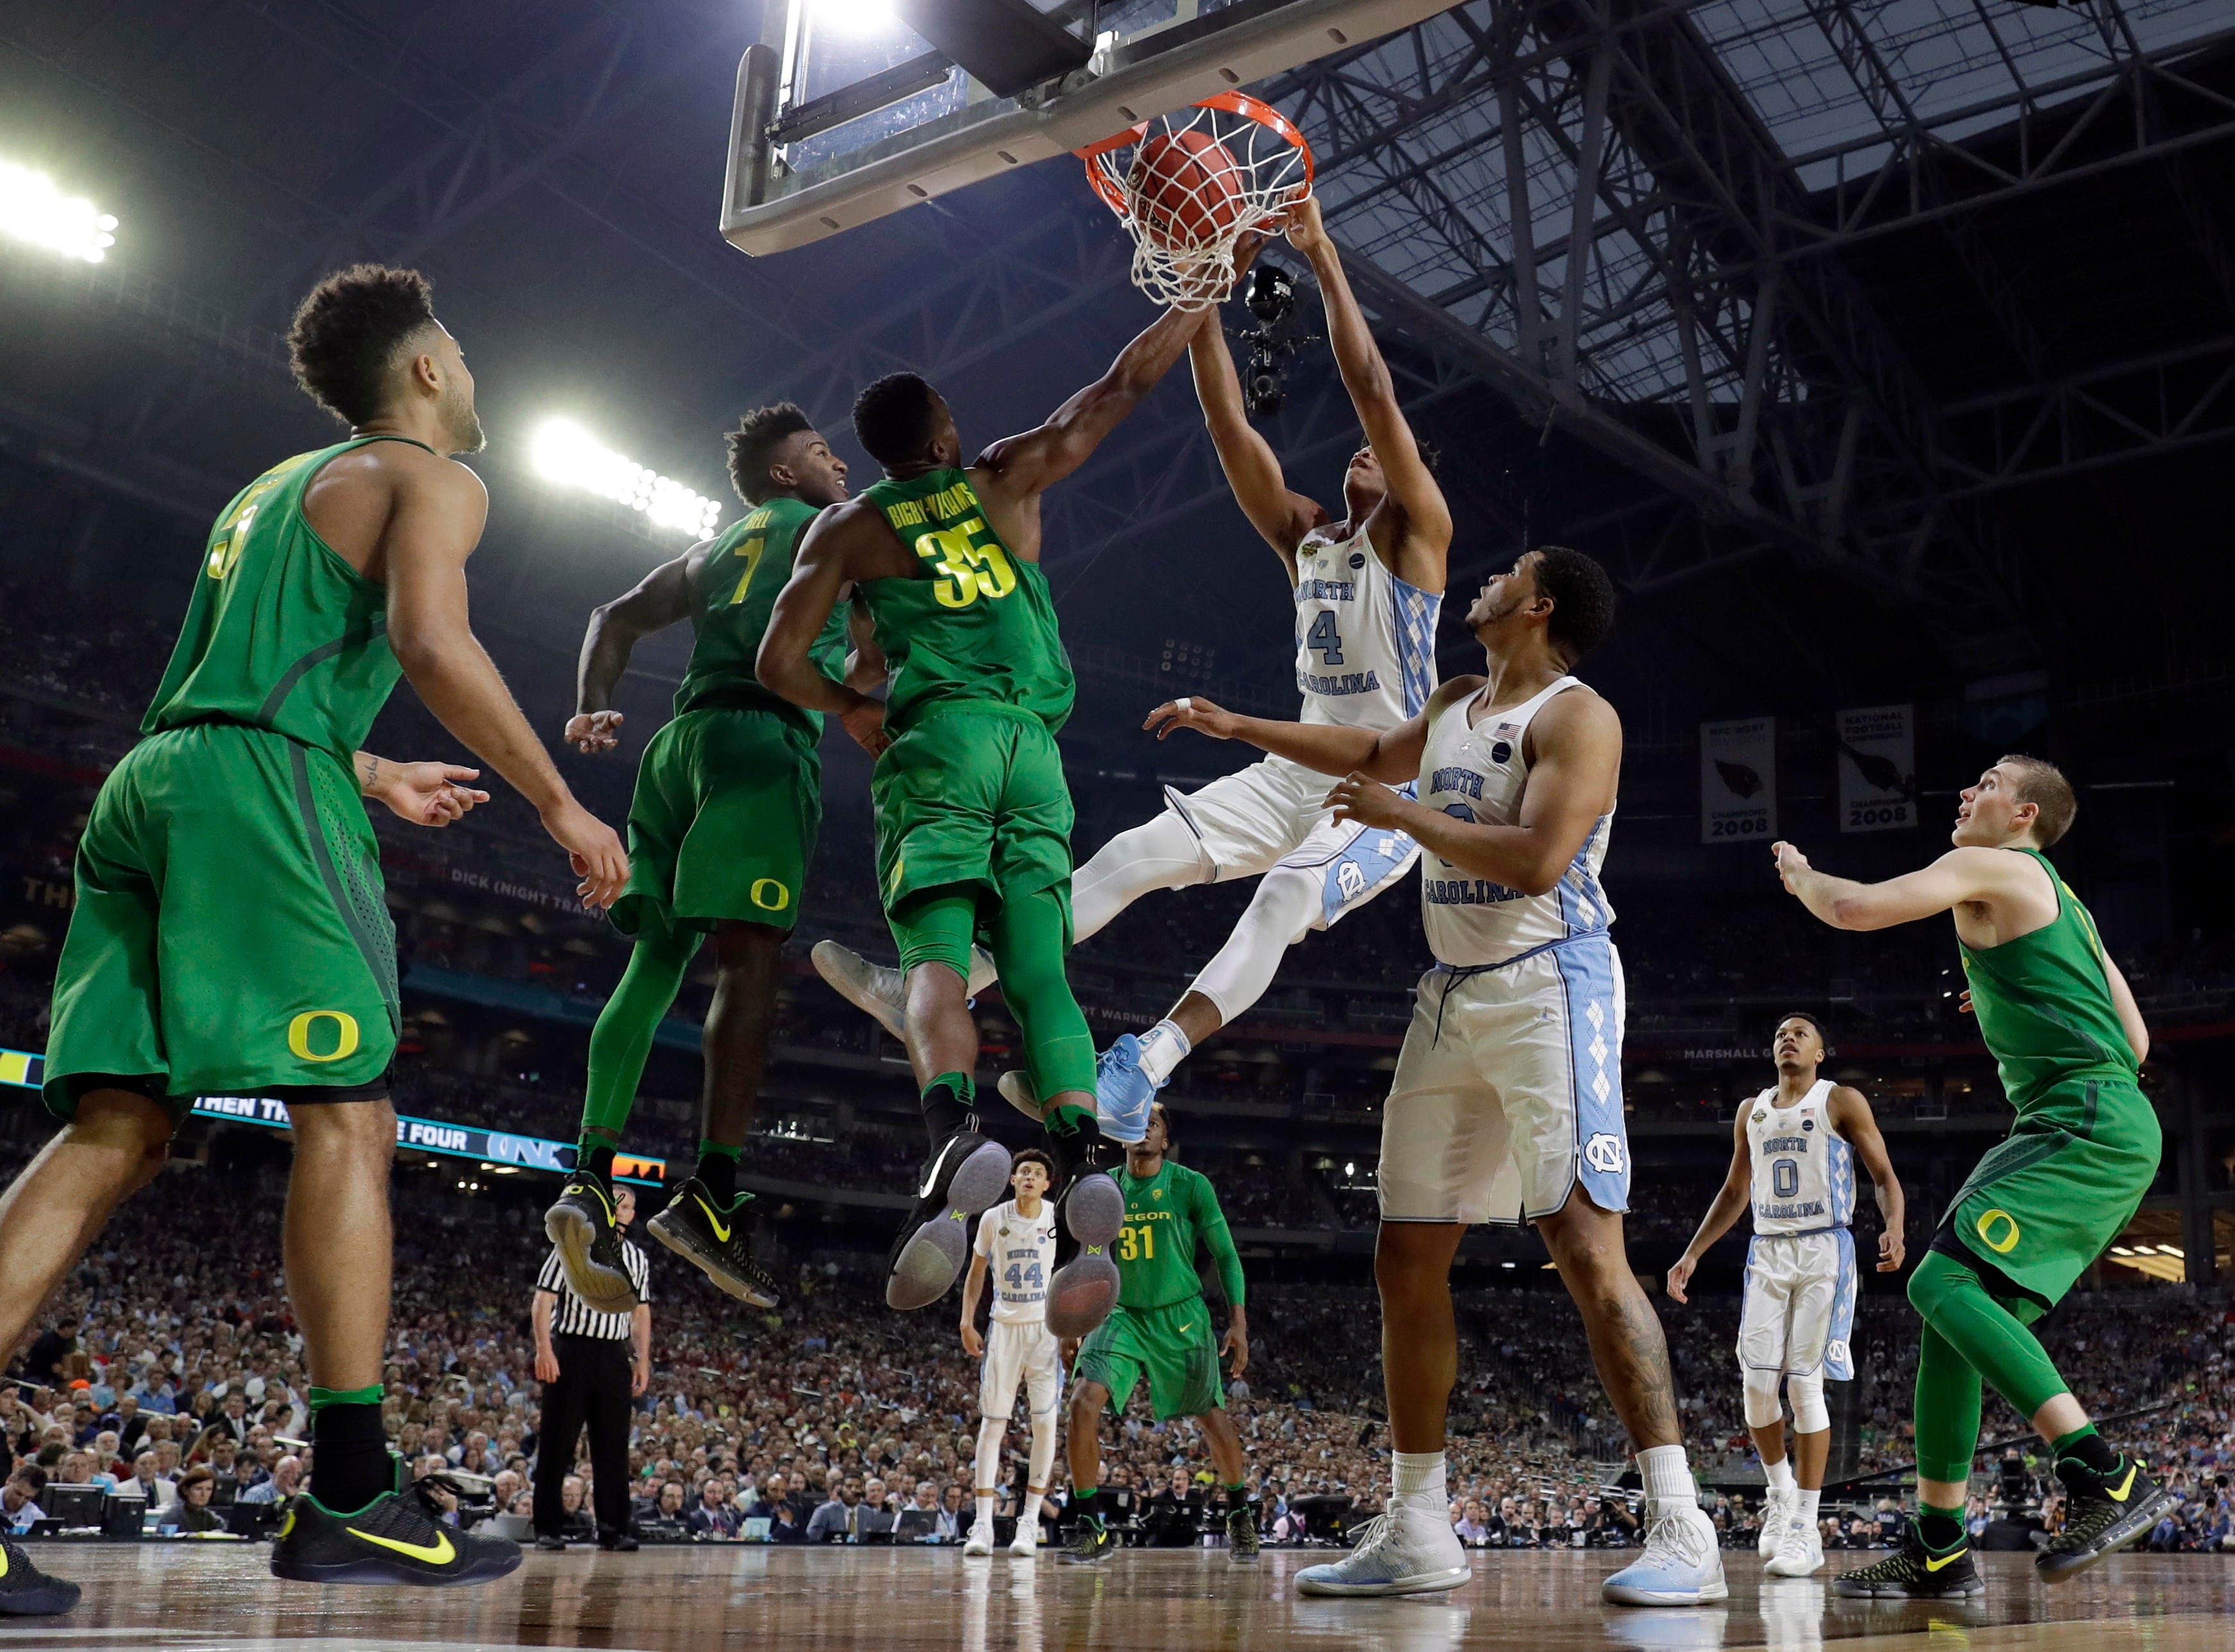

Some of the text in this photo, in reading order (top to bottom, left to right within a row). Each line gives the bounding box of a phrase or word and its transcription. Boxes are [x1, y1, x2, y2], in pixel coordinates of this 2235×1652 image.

[914, 516, 1017, 608] 35
[1294, 579, 1354, 604] NORTH
[1306, 610, 1344, 665] 4
[1845, 712, 1904, 724] NATIONAL
[1845, 722, 1904, 734] FOOTBALL
[1430, 767, 1484, 801] NORTH
[1850, 806, 1906, 826] 2008
[1711, 818, 1768, 836] 2008
[451, 868, 490, 890] DICK
[22, 876, 75, 909] TH
[1101, 1009, 1156, 1026] WARNER
[1684, 1048, 1759, 1059] MARSHALL
[409, 1124, 468, 1151] FOUR
[1762, 1136, 1808, 1155] NORTH
[1773, 1159, 1799, 1198] 0
[1123, 1211, 1171, 1222] EGON
[1758, 1200, 1825, 1219] CAROLINA
[1118, 1225, 1154, 1261] 31
[1007, 1248, 1040, 1261] NORTH
[1004, 1263, 1043, 1289] 44
